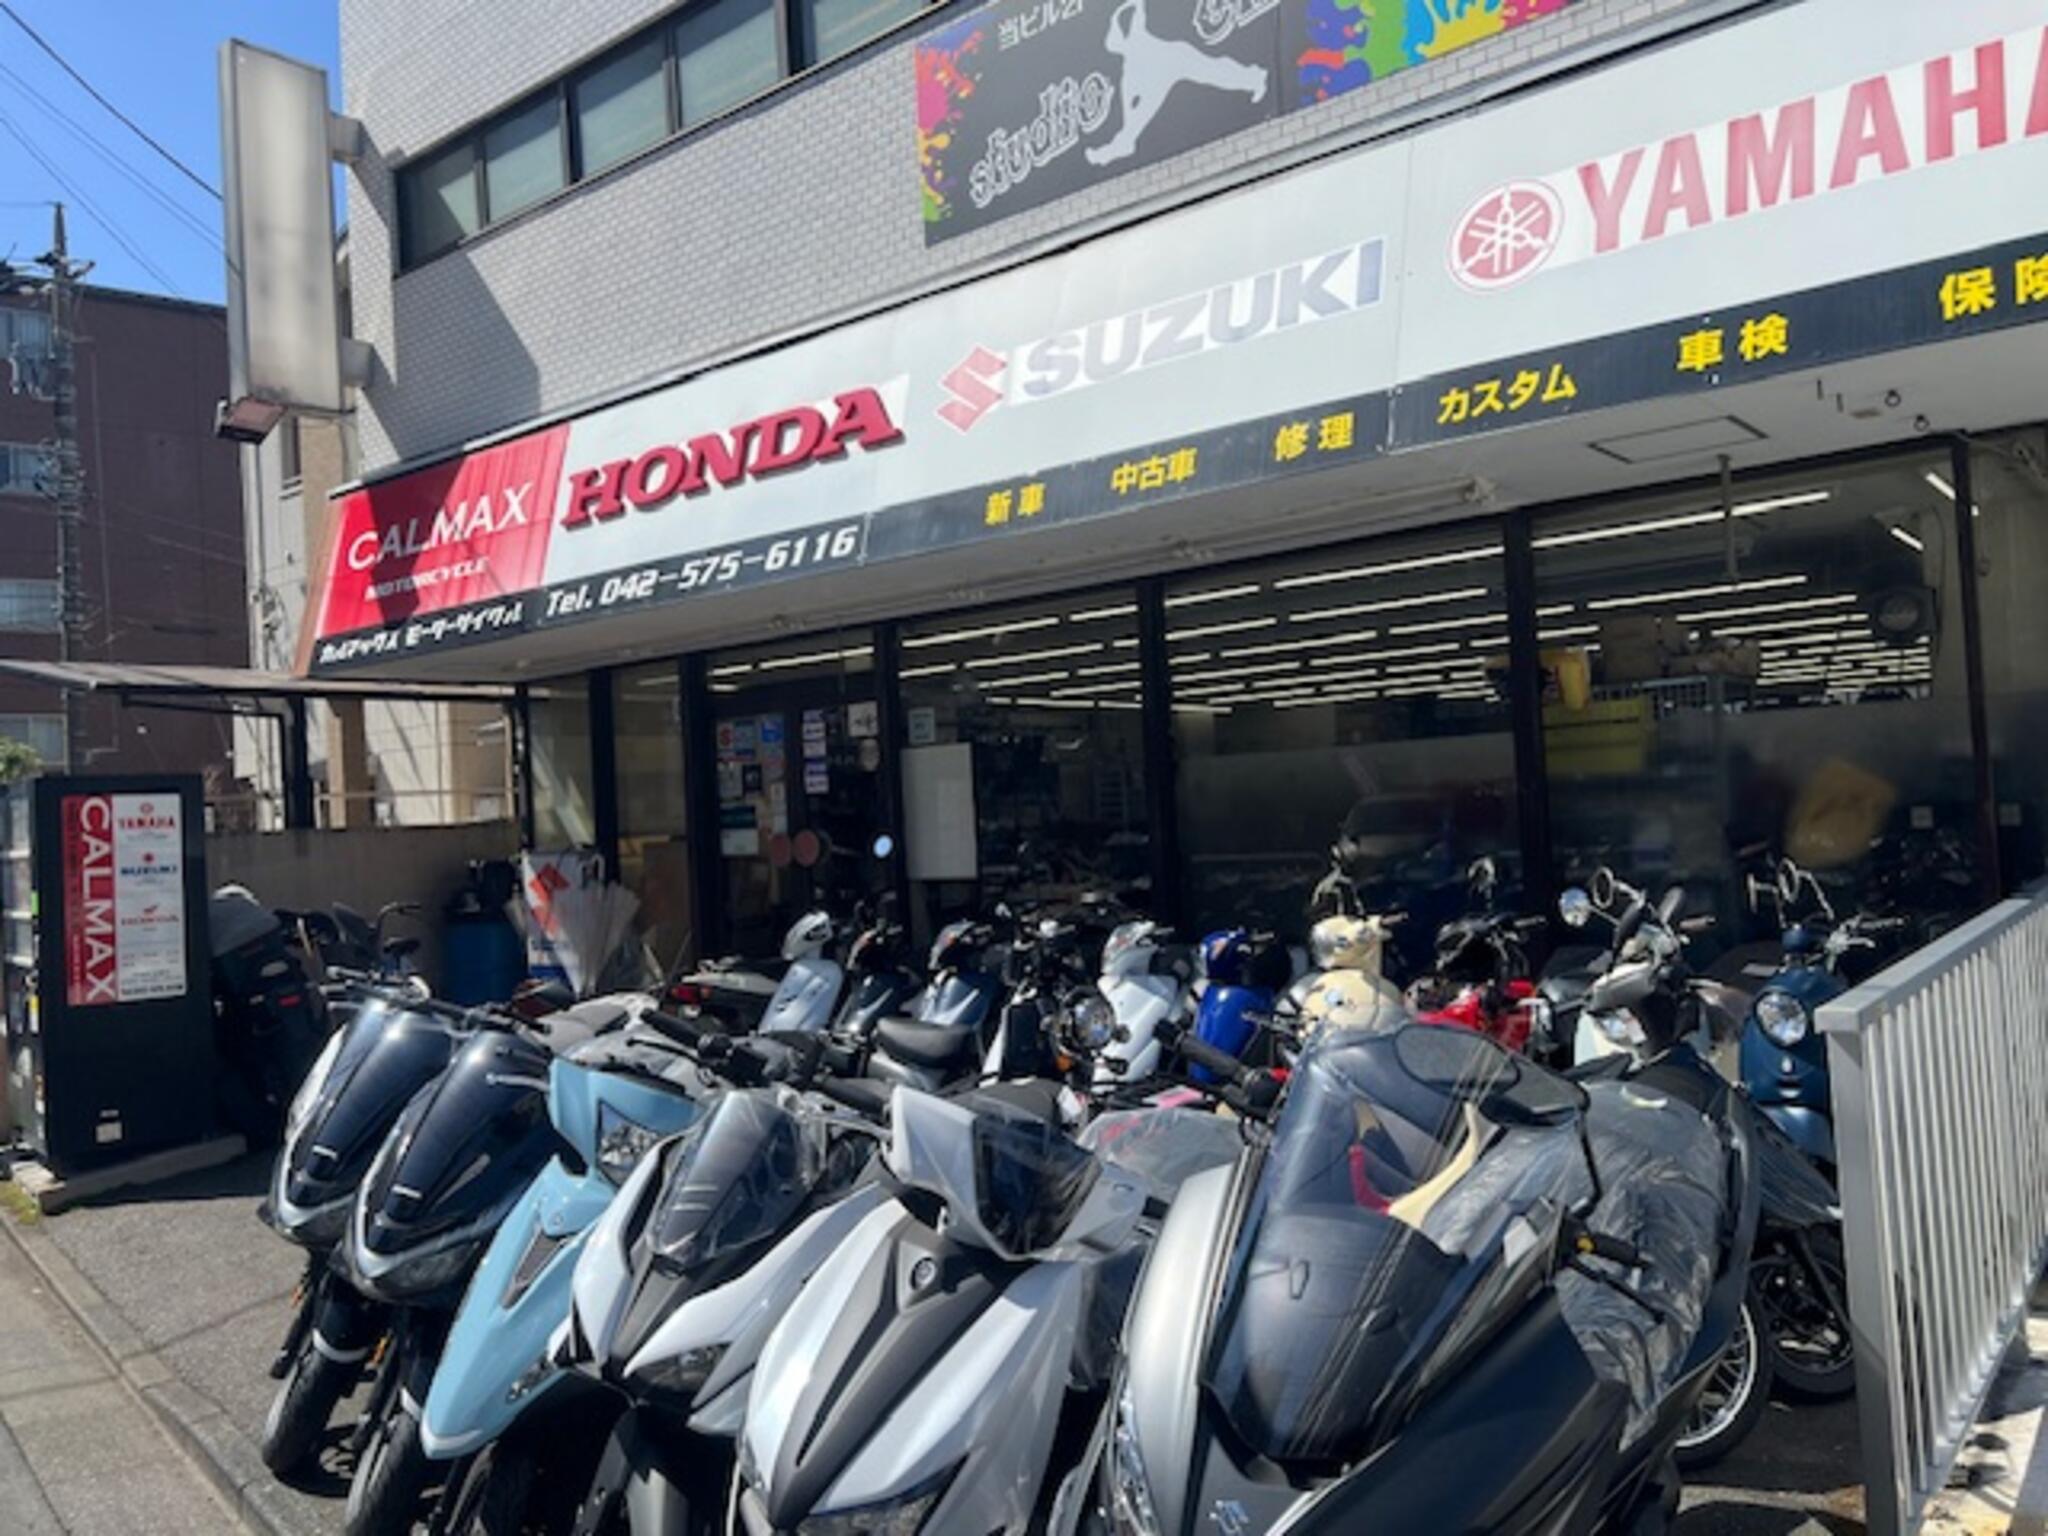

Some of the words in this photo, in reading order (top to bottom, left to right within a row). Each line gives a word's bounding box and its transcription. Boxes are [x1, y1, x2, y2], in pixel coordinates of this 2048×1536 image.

[1023, 238, 1383, 397] SUZUKI
[560, 386, 904, 530] HONDA
[1111, 446, 1198, 495] 中古車
[1437, 363, 1578, 425] カスタム
[347, 481, 533, 571] CALMAX
[547, 584, 593, 617] Tel.
[600, 524, 859, 605] 042-575-6116
[80, 796, 117, 1001] CALMAX
